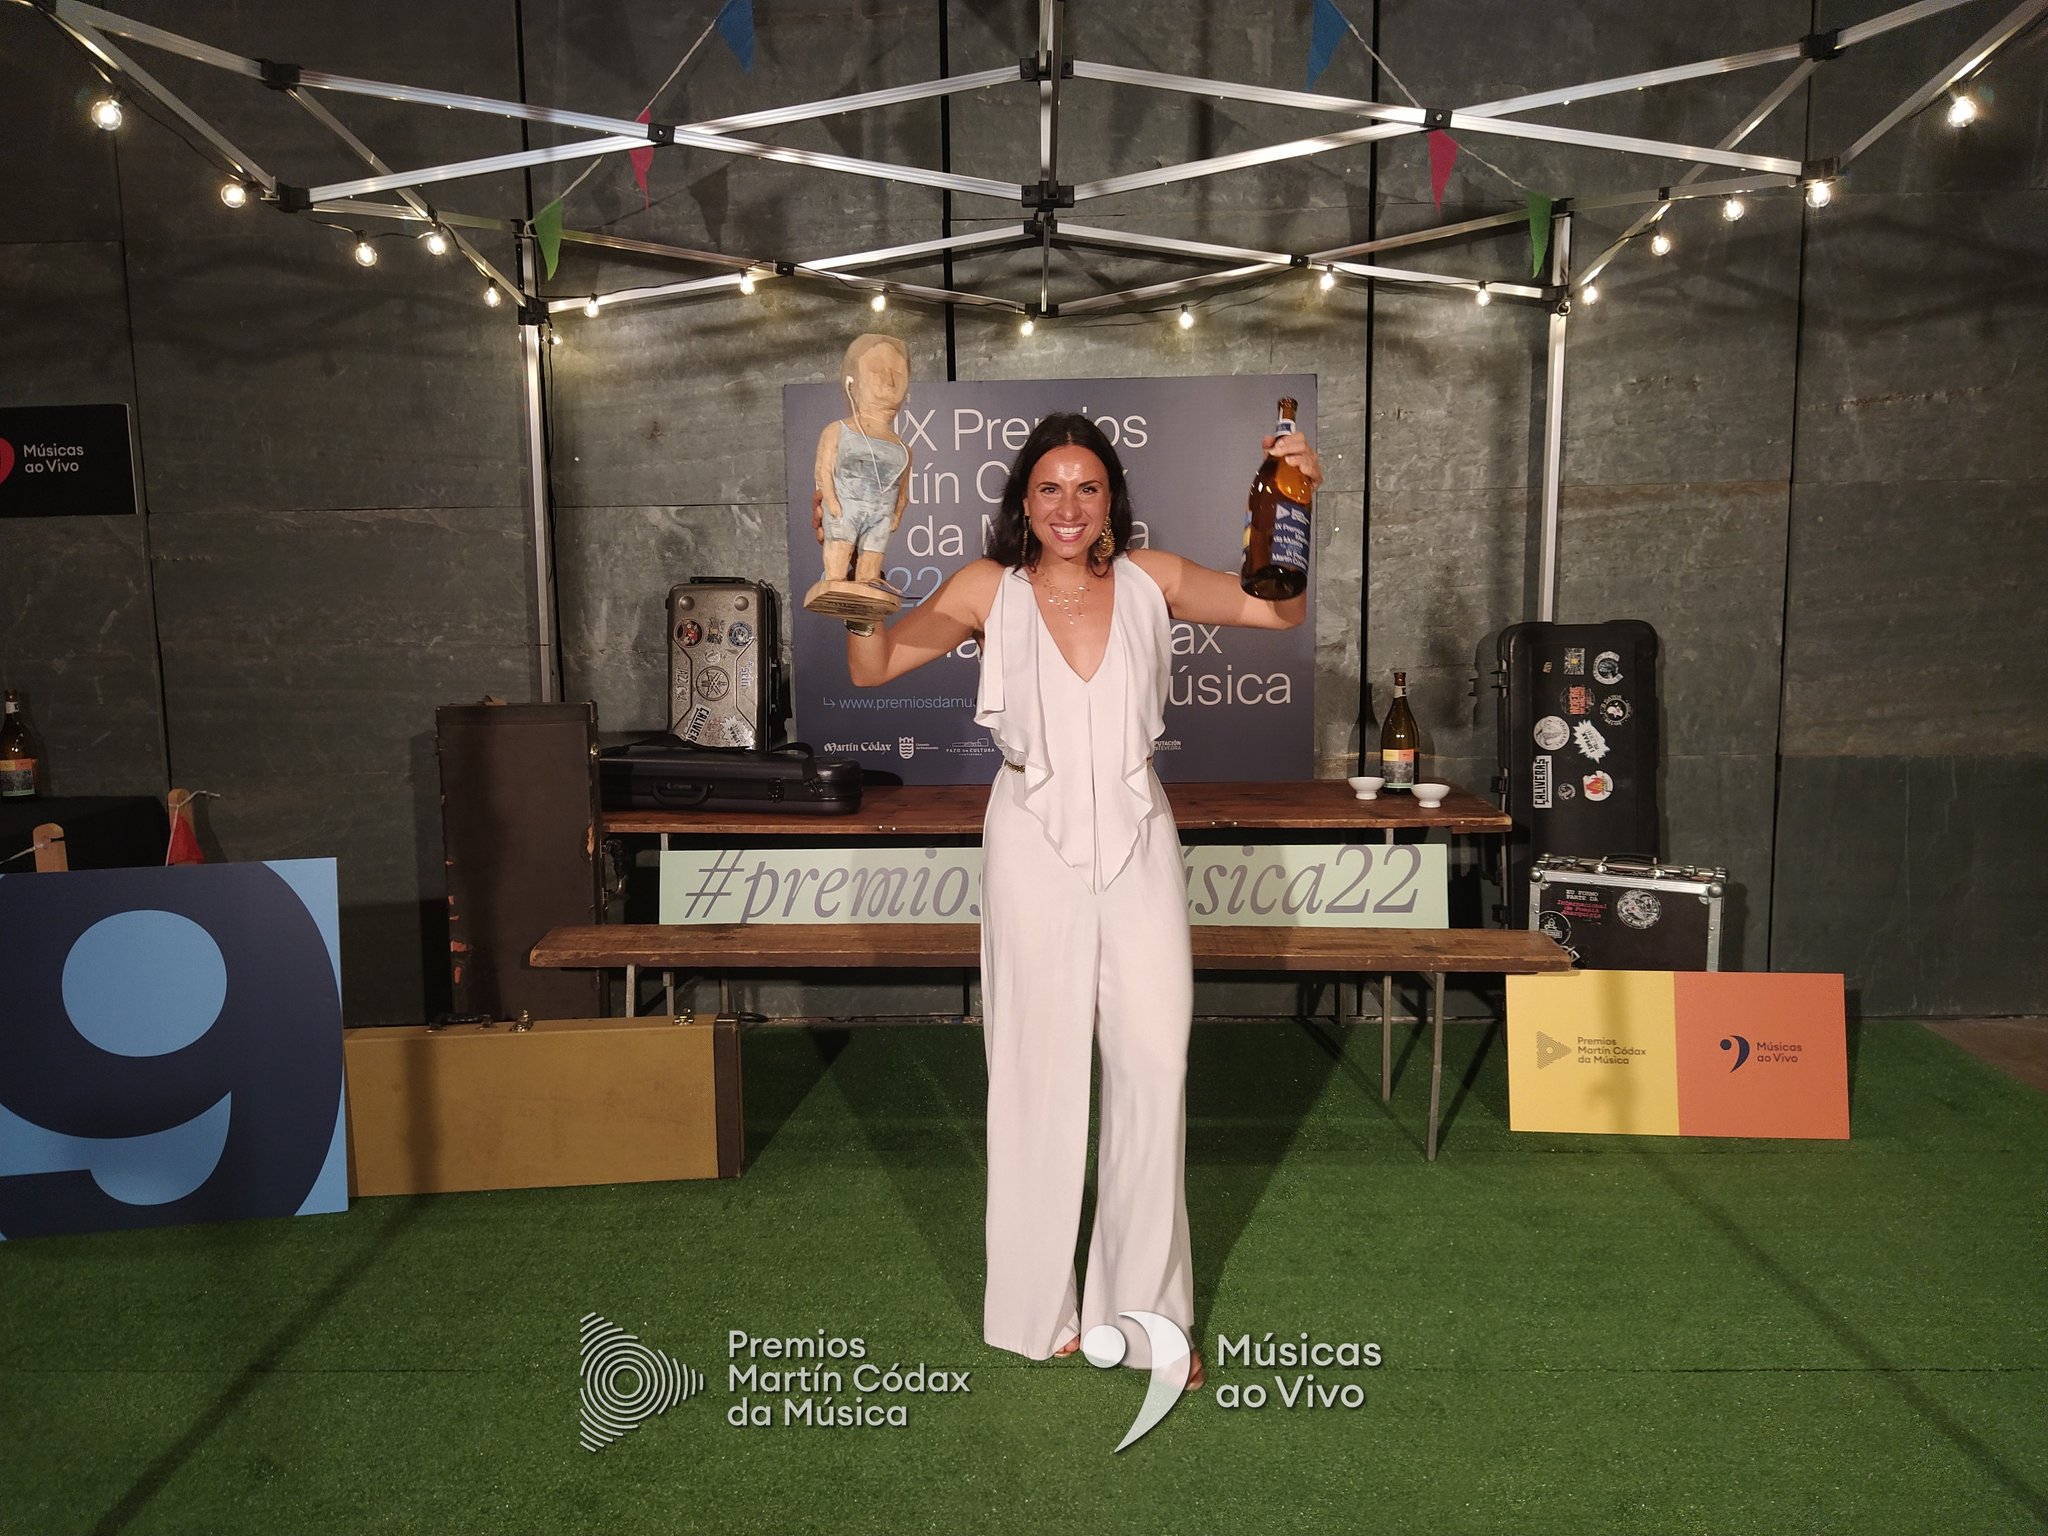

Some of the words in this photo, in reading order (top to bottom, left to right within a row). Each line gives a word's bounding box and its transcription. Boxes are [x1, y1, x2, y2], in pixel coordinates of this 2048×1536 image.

[954, 406, 1148, 451] Preos
[23, 443, 84, 457] Músicas
[25, 463, 44, 473] ao
[46, 459, 79, 472] Vivo
[907, 515, 964, 557] da
[1169, 664, 1291, 706] úsica
[688, 707, 710, 741] CALIVER
[823, 742, 859, 755] Martín
[860, 740, 892, 755] Códax
[1534, 758, 1546, 805] CALIVERAS
[1577, 1036, 1617, 1046] Premios
[1756, 1041, 1803, 1052] Músicas
[1577, 1046, 1611, 1055] Martín
[1612, 1046, 1647, 1056] Códax
[1757, 1055, 1771, 1063] ao
[1773, 1053, 1799, 1063] Vivo
[1578, 1055, 1591, 1064] da
[1593, 1055, 1629, 1065] Música
